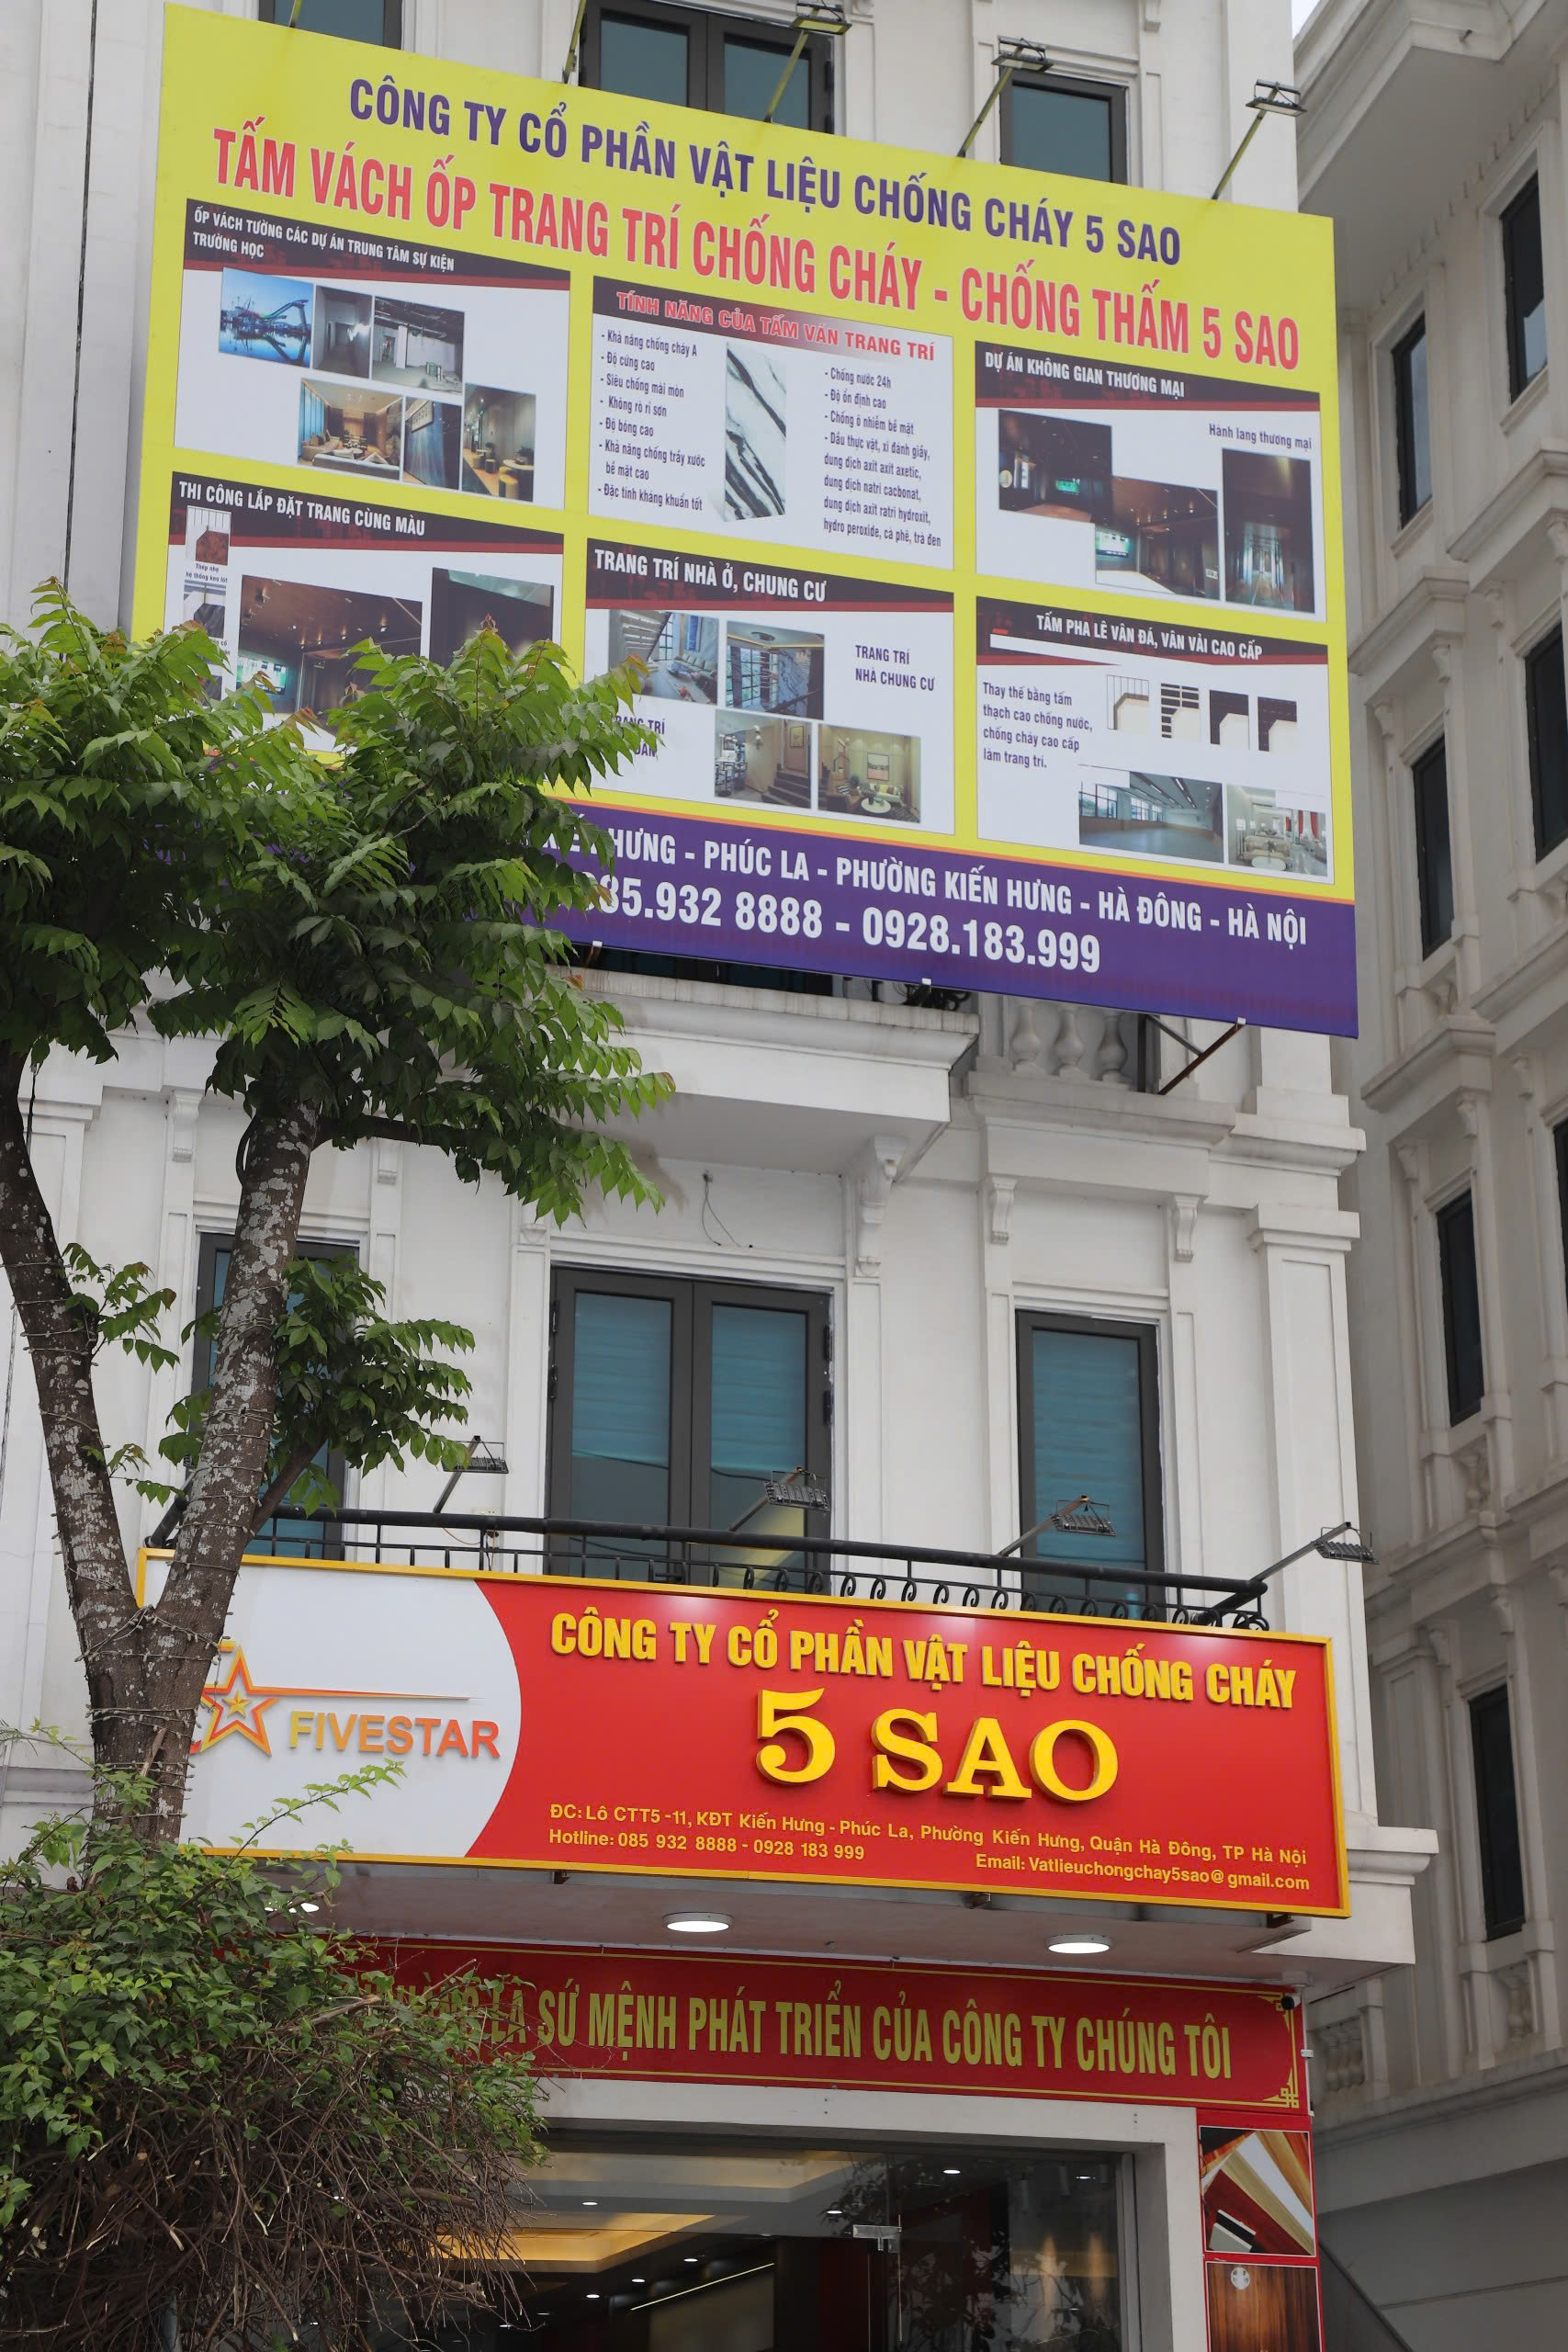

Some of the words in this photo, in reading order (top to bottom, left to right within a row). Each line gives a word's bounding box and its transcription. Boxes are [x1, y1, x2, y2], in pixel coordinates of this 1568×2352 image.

[349, 74, 450, 136] CÔNG
[463, 99, 507, 145] TY
[519, 101, 568, 158] CỔ
[581, 120, 676, 179] PHẦN
[689, 140, 757, 198] VẬT
[768, 156, 840, 215] LIỆU
[854, 171, 972, 232] CHỐNG
[985, 198, 1074, 248] CHÁY
[1085, 215, 1104, 254] 5
[1117, 220, 1181, 266] SAO
[193, 232, 237, 254] TRƯỜNG
[241, 241, 265, 259] HỌC
[194, 206, 209, 222] ỐP
[213, 212, 243, 231] VÁCH
[246, 220, 283, 239] TƯỜNG
[286, 226, 308, 243] CÁC
[312, 232, 327, 249] DỰ
[330, 233, 344, 251] ÁN
[347, 240, 384, 258] TRUNG
[386, 243, 410, 263] TÂM
[430, 254, 455, 272] KIỆN
[213, 116, 296, 198] TẤM
[310, 141, 412, 222] VÁCH
[426, 154, 476, 231] ỐP
[489, 182, 608, 258] TRANG
[622, 202, 680, 270] TRÍ
[693, 212, 816, 294] CHỐNG
[829, 242, 922, 311] CHÁY
[961, 259, 1080, 337] CHỐNG
[1092, 279, 1190, 355] THẤM
[1201, 307, 1222, 360] 5
[1235, 309, 1299, 371] SAO
[616, 291, 660, 315] TÍNH
[665, 300, 713, 324] NĂNG
[718, 305, 756, 333] CỦA
[760, 315, 798, 340] TẤM
[844, 332, 901, 356] TRANG
[907, 340, 936, 361] TRÍ
[985, 350, 1004, 373] DỰ
[1006, 352, 1023, 373] ÁN
[1027, 356, 1070, 380] KHÔNG
[1073, 364, 1102, 386] GIAN
[1106, 369, 1157, 394] THƯƠNG
[1161, 379, 1185, 399] MẠI
[1209, 424, 1233, 439] Hành
[1236, 428, 1257, 445] lang
[1259, 432, 1292, 450] thương
[1295, 437, 1312, 452] mại
[179, 481, 200, 500] THI
[206, 483, 243, 507] CÔNG
[248, 489, 273, 511] LẮP
[276, 496, 303, 519] ĐẶT
[307, 502, 351, 525] TRANG
[355, 507, 391, 531] CÙNG
[395, 514, 425, 537] MÀU
[595, 548, 648, 575] TRANG
[653, 557, 678, 581] TRÍ
[684, 561, 716, 586] NHÀ
[743, 571, 797, 598] CHUNG
[803, 581, 828, 603] CƯ
[855, 645, 889, 662] TRANG
[893, 649, 909, 664] TRÍ
[1036, 612, 1062, 632] TẤM
[1066, 619, 1090, 637] PHA
[1095, 621, 1108, 639] LÊ
[1111, 624, 1135, 642] VÂN
[1161, 630, 1185, 649] VÂN
[1211, 639, 1235, 656] CAO
[1238, 640, 1262, 660] CẤP
[855, 667, 876, 683] NHÀ
[880, 672, 917, 688] CHUNG
[920, 677, 935, 691] CƯ
[983, 682, 1006, 698] Thay
[1009, 686, 1023, 700] thế
[1027, 687, 1051, 706] bằng
[1055, 689, 1072, 707] tấm
[983, 705, 1010, 724] thạch
[1014, 709, 1031, 722] cao
[1034, 711, 1064, 731] chống
[983, 726, 1012, 745] chống
[1016, 731, 1038, 750] cháy
[1042, 736, 1058, 748] cao
[1062, 735, 1079, 752] cấp
[983, 748, 1001, 763] làm
[1004, 752, 1031, 768] trang
[705, 838, 772, 876] PHÚC
[781, 850, 809, 882] LA
[837, 855, 937, 898] PHƯỜNG
[944, 865, 998, 906] KIẾN
[1007, 883, 1073, 917] HƯNG
[1098, 887, 1130, 924] HÀ
[1137, 892, 1201, 932] ĐÔNG
[1228, 904, 1260, 939] HÀ
[1268, 909, 1307, 951] NỘI
[735, 891, 823, 939] 8888
[863, 905, 1100, 974] 0928.183.999
[551, 1606, 658, 1662] CÔNG
[669, 1623, 715, 1665] TY
[727, 1606, 778, 1668] CỔ
[790, 1619, 894, 1678] PHẦN
[903, 1634, 968, 1692] VẬT
[982, 1640, 1061, 1698] LIỆU
[1072, 1642, 1194, 1703] CHỐNG
[1205, 1658, 1297, 1710] CHÁY
[288, 1709, 501, 1758] FIVESTAR
[757, 1687, 836, 1784] 5
[871, 1708, 1119, 1802] SAO
[585, 1805, 608, 1821] Lô
[614, 1806, 661, 1823] CTT5
[696, 1812, 733, 1827] KĐT
[739, 1813, 777, 1830] Kiến
[783, 1816, 825, 1836] Hưng
[840, 1819, 881, 1838] Phúc
[920, 1825, 985, 1847] Phường
[992, 1826, 1031, 1846] Kiến
[1089, 1835, 1134, 1856] Quận
[1139, 1838, 1161, 1856] Hà
[1223, 1845, 1246, 1861] TP
[1251, 1847, 1273, 1863] Hà
[1280, 1849, 1308, 1866] Nội
[617, 1833, 649, 1849] 085
[656, 1835, 687, 1850] 932
[695, 1837, 737, 1852] 8888
[753, 1839, 794, 1856] 0928
[800, 1843, 829, 1858] 183
[833, 1845, 864, 1860] 999
[538, 1979, 581, 2047] SỨ
[589, 1981, 676, 2061] MỆNH
[689, 1985, 766, 2053] PHÁT
[775, 1979, 862, 2058] TRIỂN
[873, 1989, 933, 2063] CỦA
[942, 1998, 1023, 2069] CÔNG
[1031, 2015, 1066, 2069] TY
[1075, 2007, 1177, 2076] CHÚNG
[1183, 2012, 1233, 2080] TÔI
